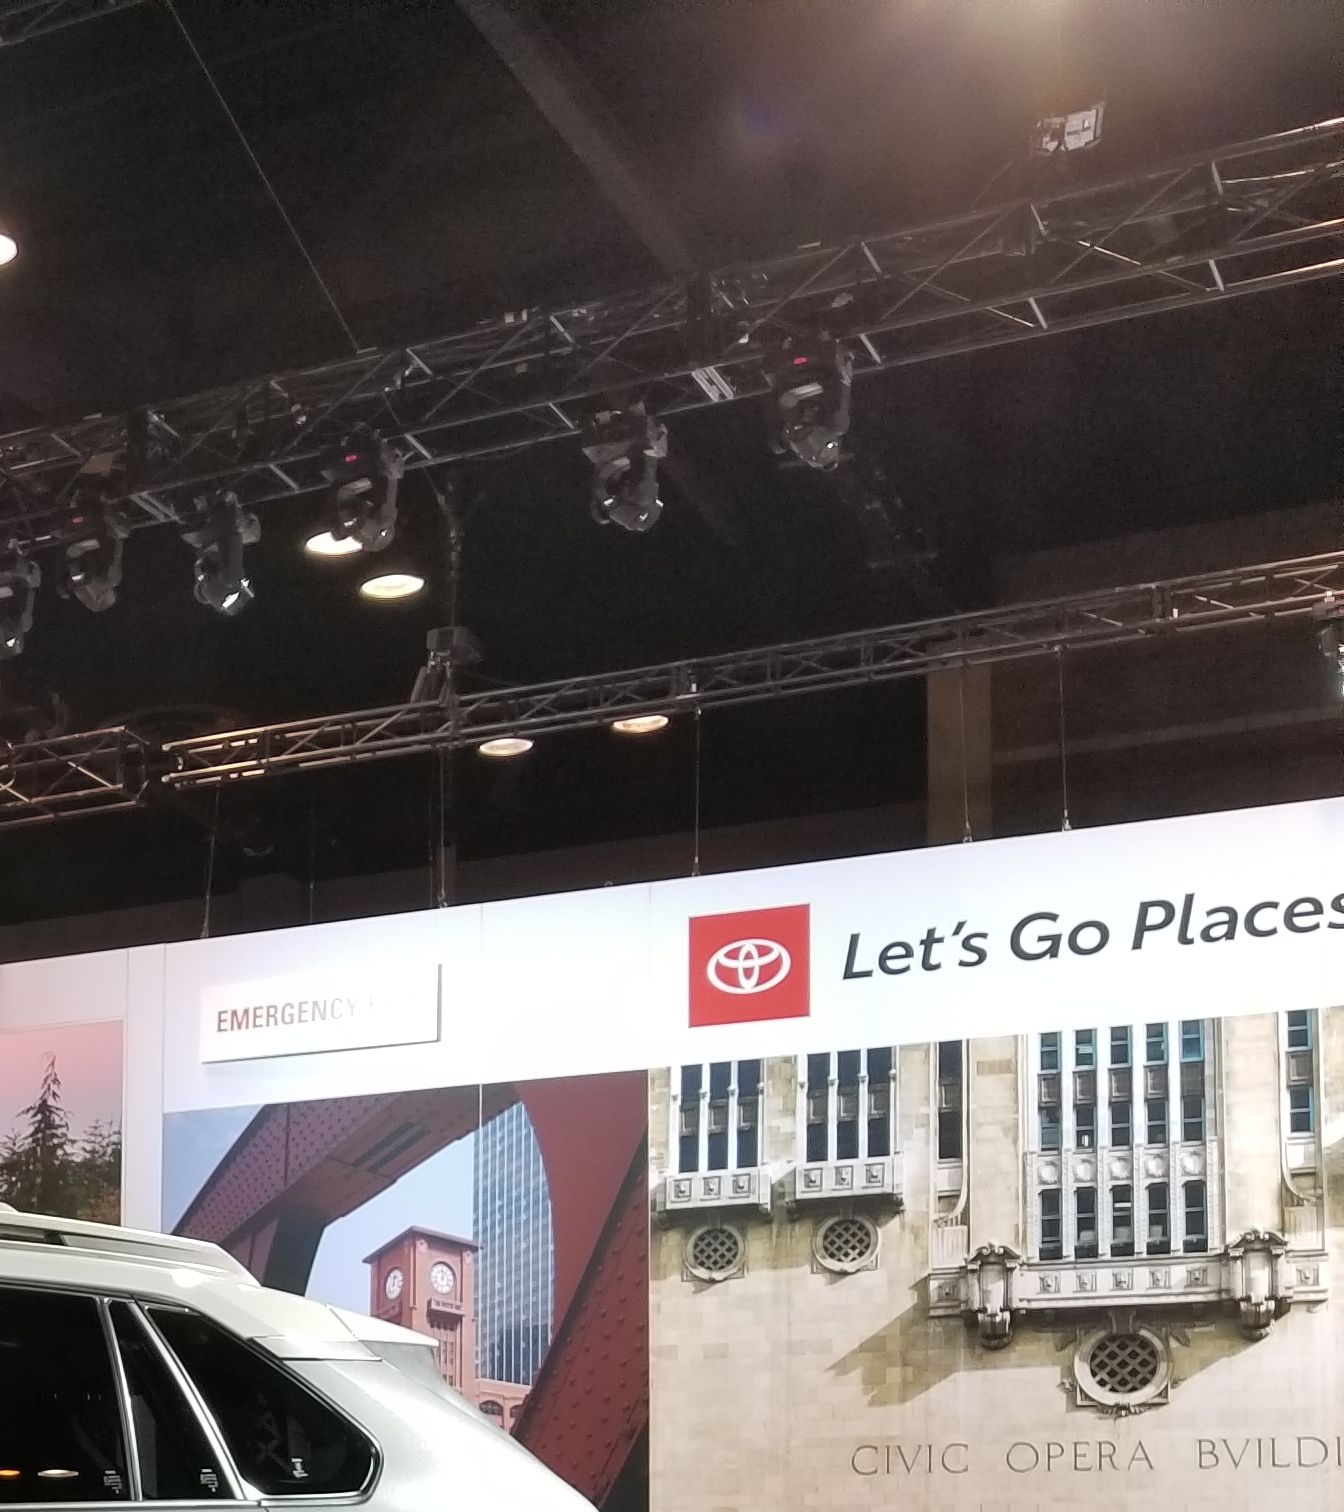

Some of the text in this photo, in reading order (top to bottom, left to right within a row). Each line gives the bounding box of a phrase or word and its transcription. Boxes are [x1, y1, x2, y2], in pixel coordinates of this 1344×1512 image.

[1010, 911, 1110, 961] Go
[216, 997, 358, 1033] EMERGENCY
[850, 1442, 969, 1476] CIVIC
[1006, 1440, 1155, 1474] OPERA
